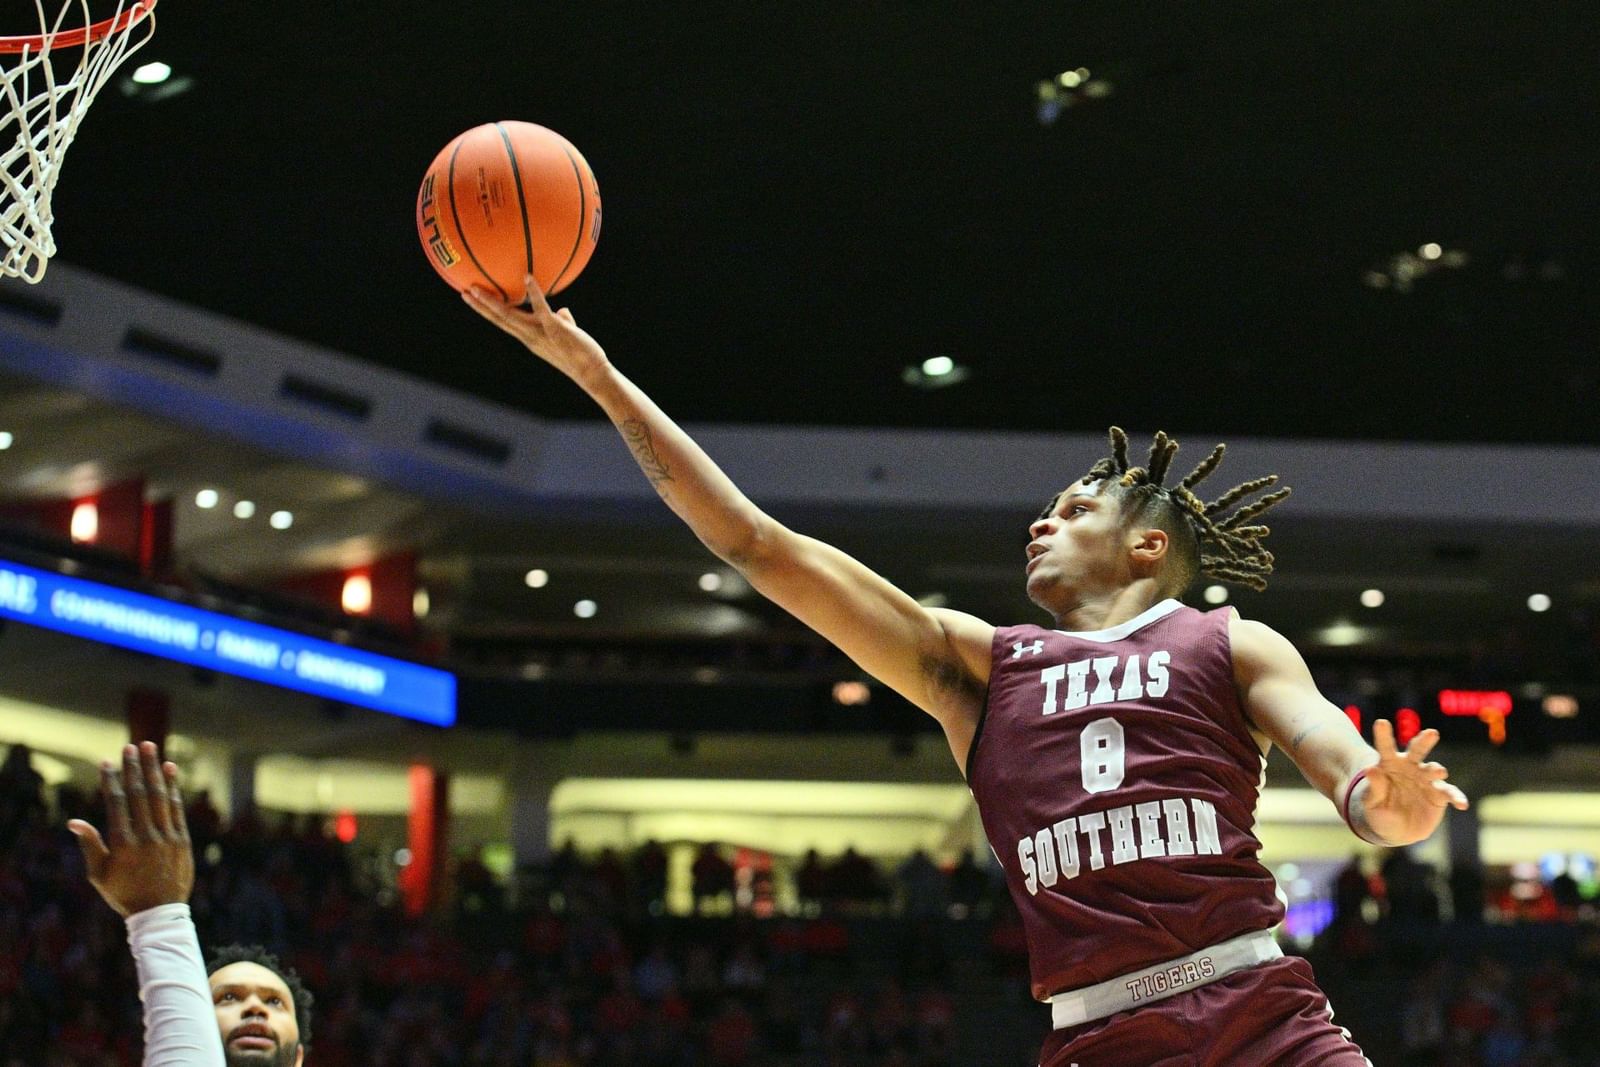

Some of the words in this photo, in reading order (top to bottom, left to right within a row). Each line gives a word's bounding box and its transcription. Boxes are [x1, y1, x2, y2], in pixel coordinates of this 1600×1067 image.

[1040, 651, 1171, 715] TEXAS
[1080, 717, 1125, 794] 8
[1017, 798, 1223, 896] SOUTHERN
[1126, 957, 1216, 1002] TIGERS
